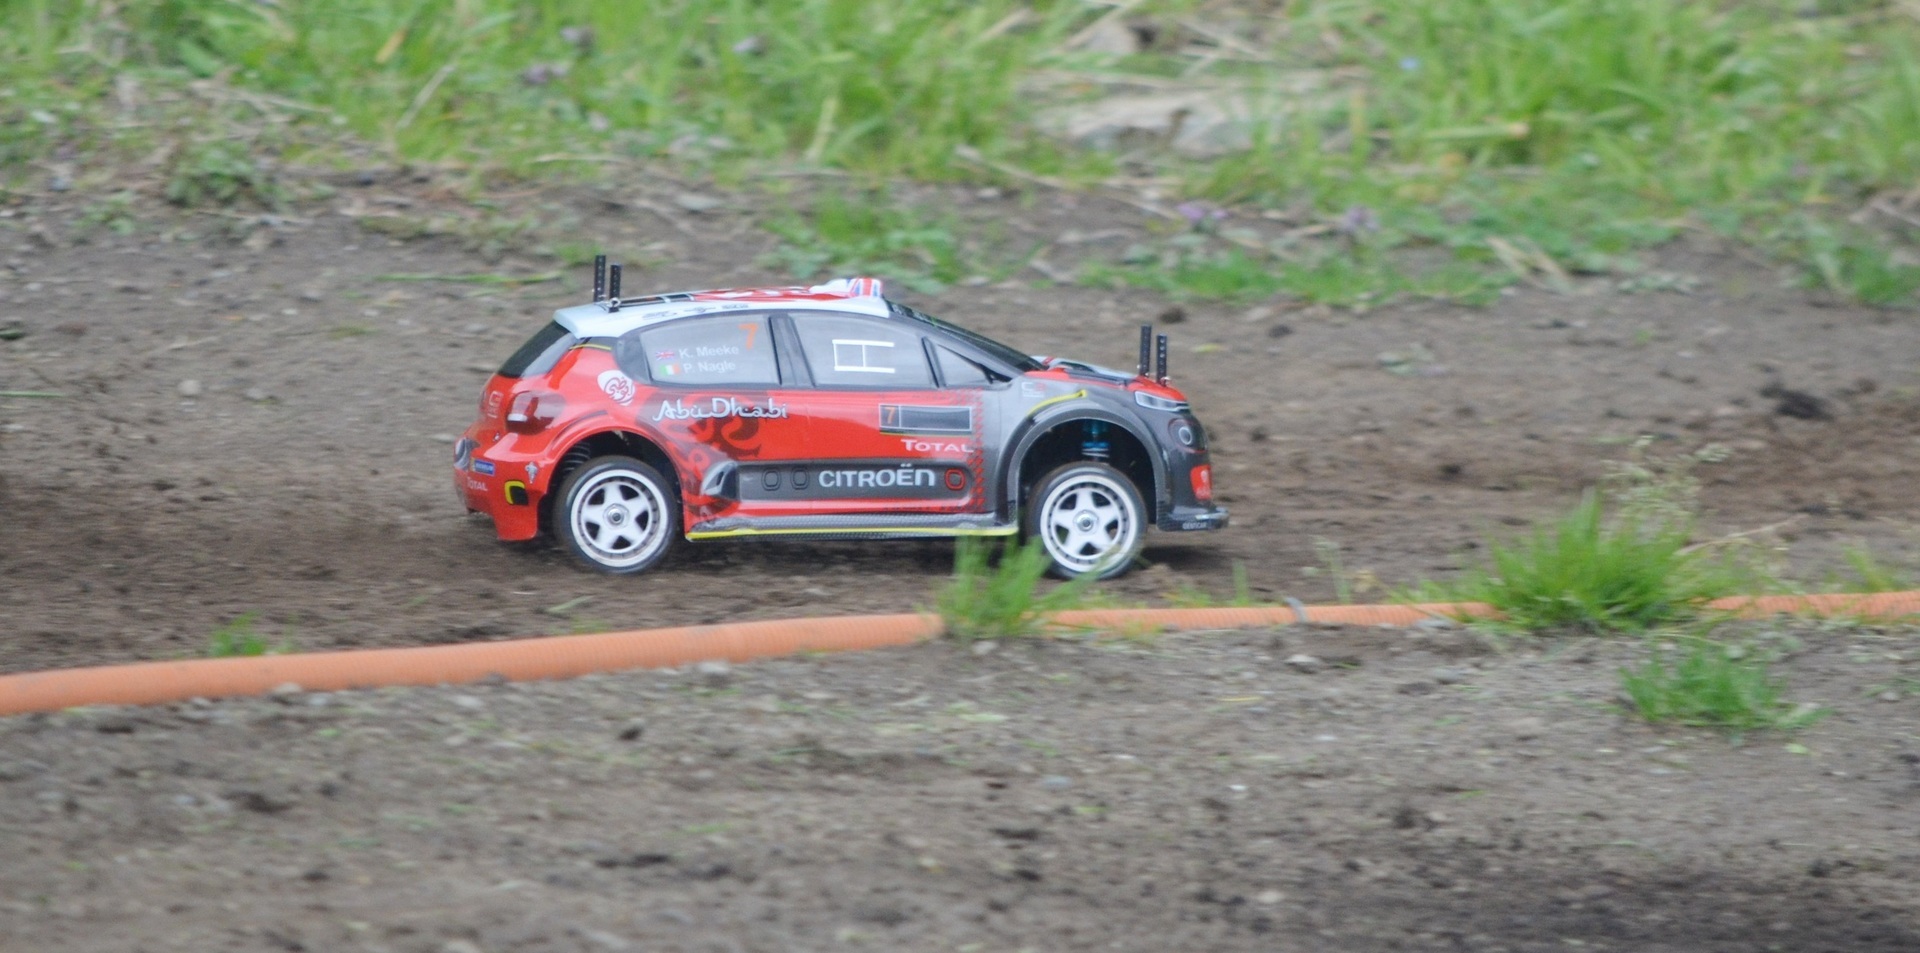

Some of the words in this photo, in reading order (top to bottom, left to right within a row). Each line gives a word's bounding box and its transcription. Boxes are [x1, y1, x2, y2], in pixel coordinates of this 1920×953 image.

[738, 322, 758, 351] 7
[679, 347, 694, 359] K.
[696, 345, 740, 358] Meeke
[683, 362, 696, 373] P.
[698, 361, 737, 373] Nagle
[884, 406, 897, 425] 7
[900, 438, 975, 454] TOTAL
[818, 463, 936, 488] CITROËN
